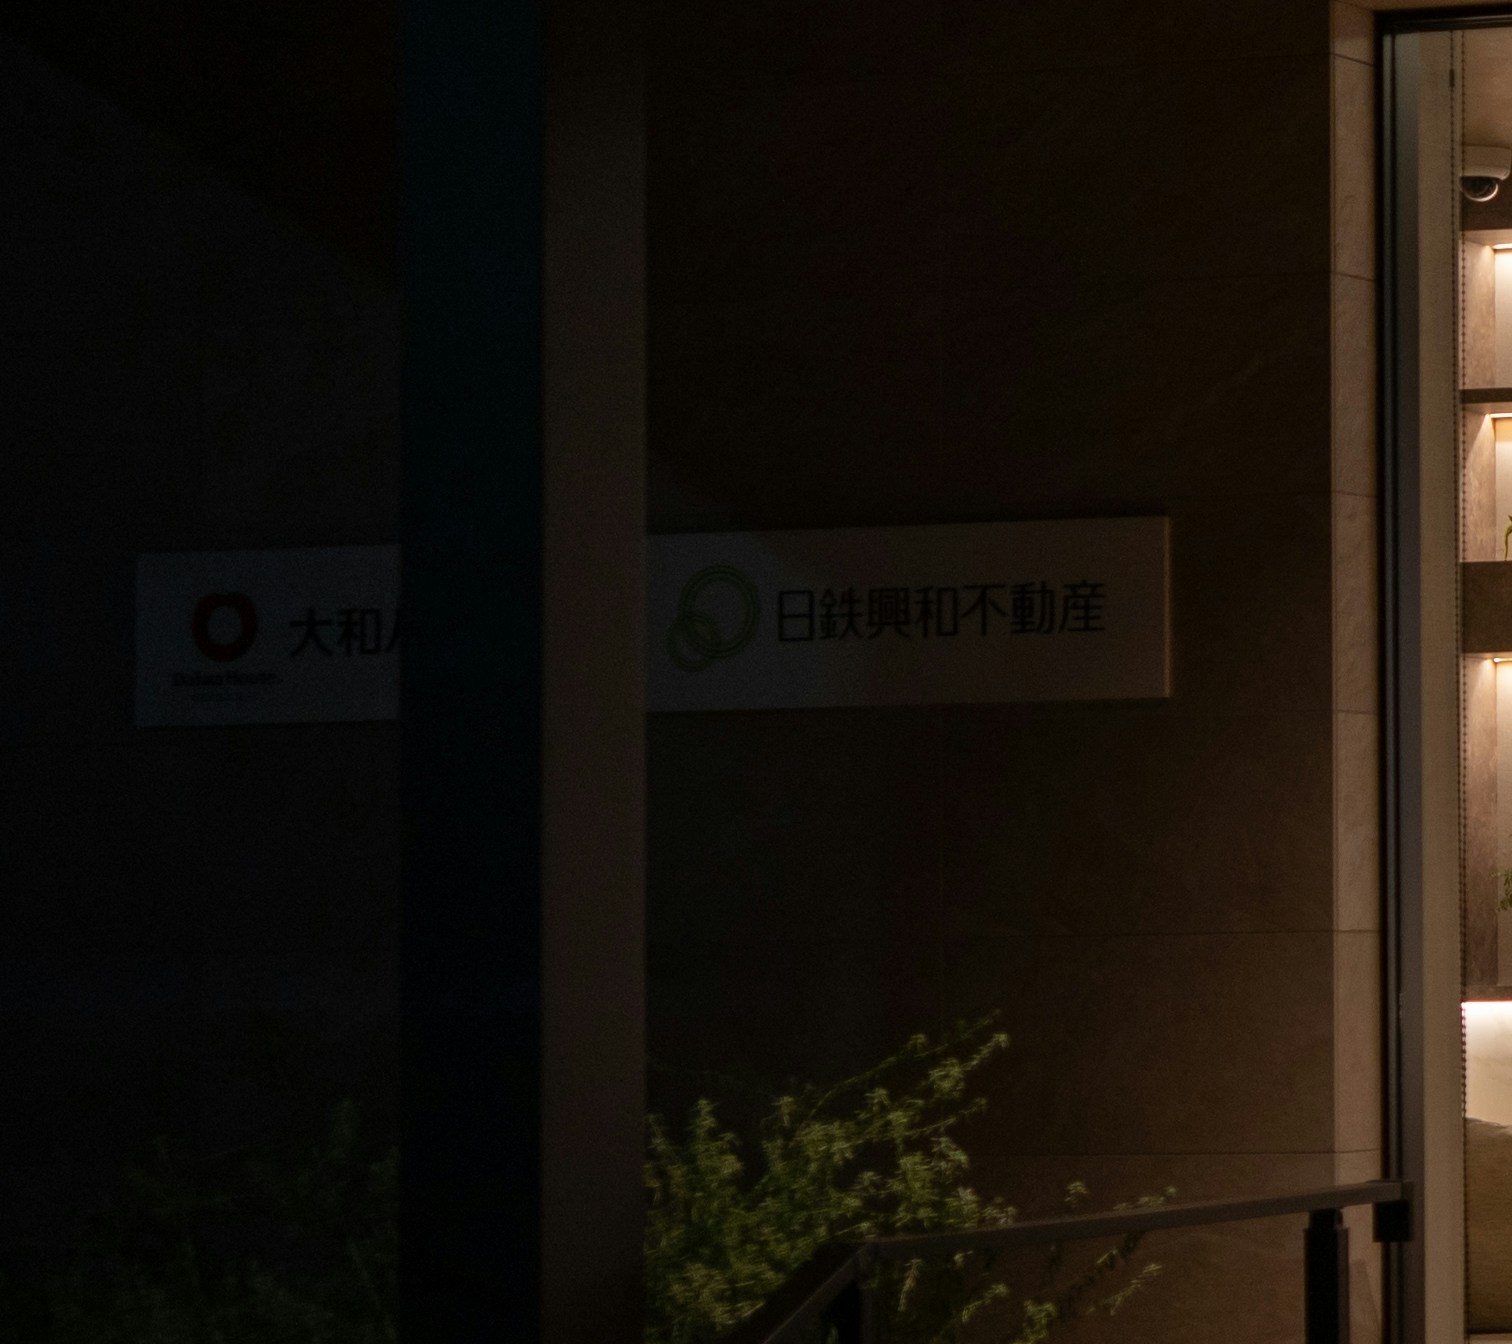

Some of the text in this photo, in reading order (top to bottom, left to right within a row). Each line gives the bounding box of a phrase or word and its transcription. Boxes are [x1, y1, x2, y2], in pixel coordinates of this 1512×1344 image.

[776, 579, 1106, 643] 日鉄興和不動産
